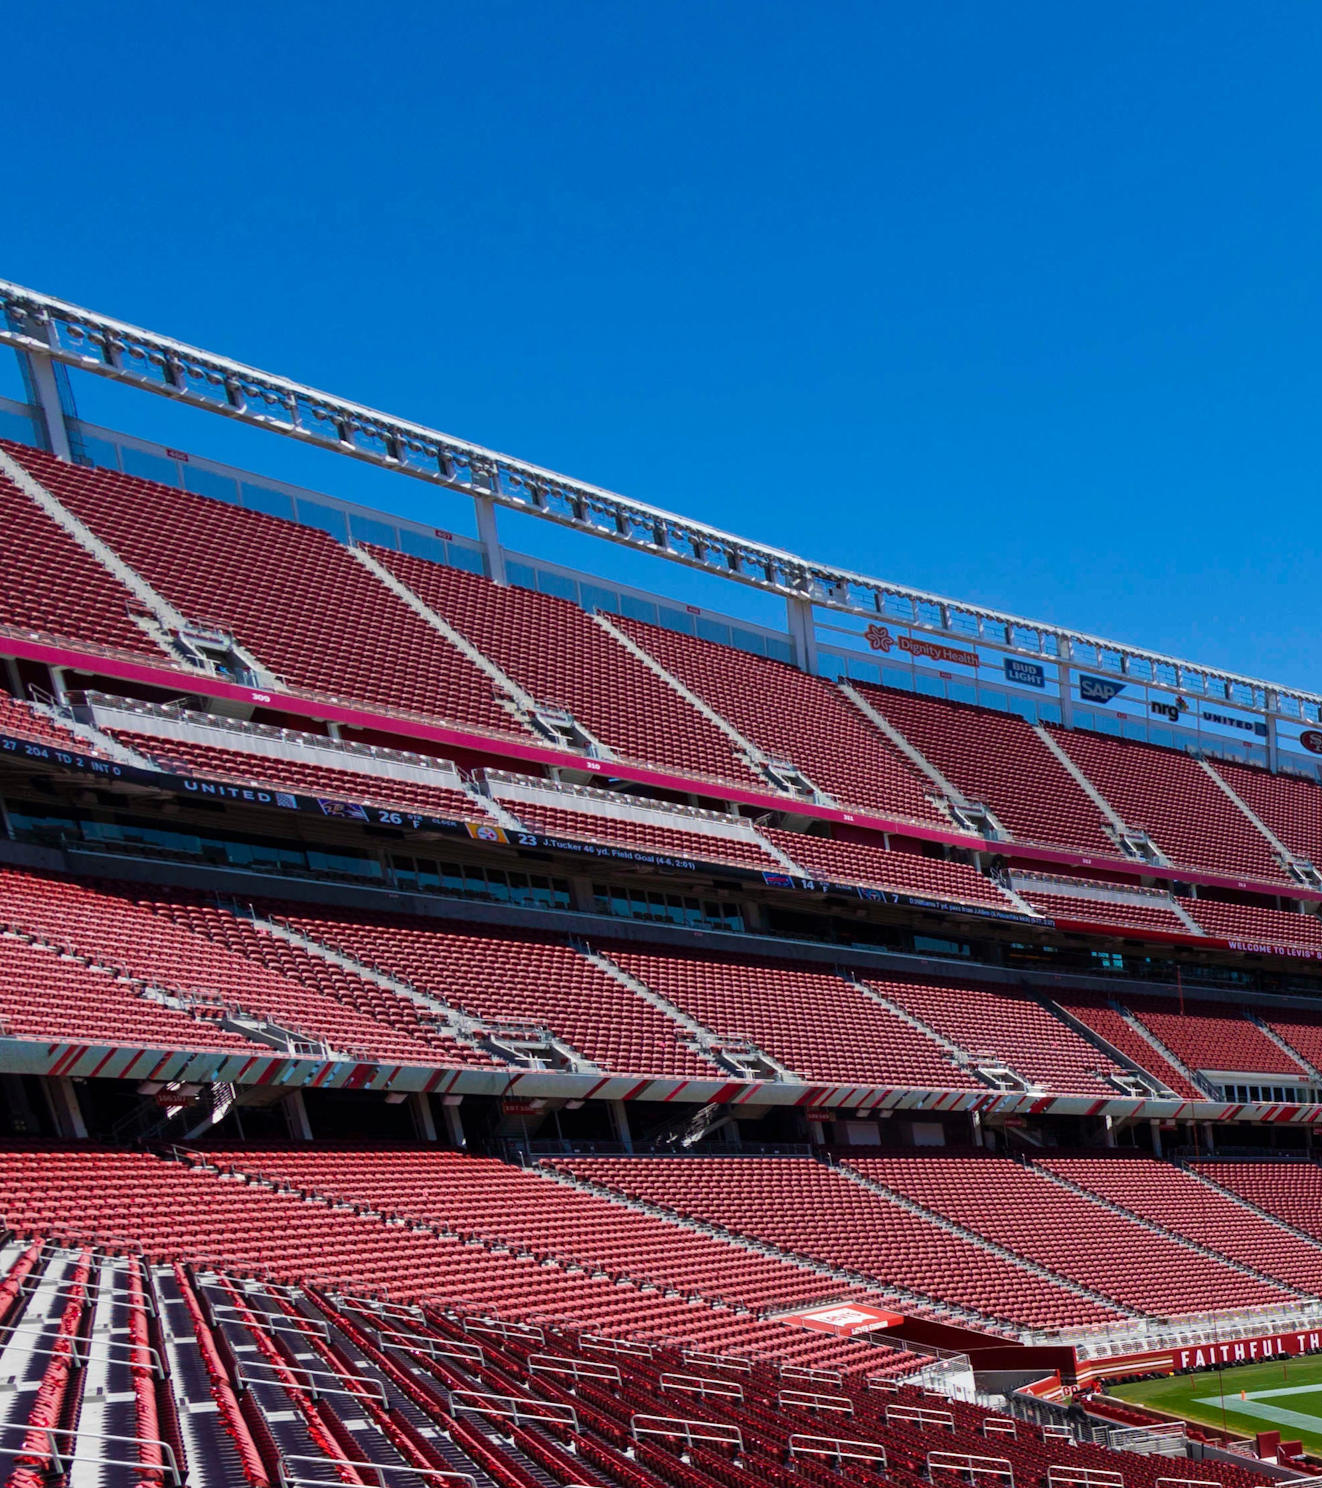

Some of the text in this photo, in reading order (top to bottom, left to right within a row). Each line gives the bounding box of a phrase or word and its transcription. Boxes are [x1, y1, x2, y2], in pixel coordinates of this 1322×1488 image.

[901, 638, 979, 667] Dignity Health
[1009, 669, 1042, 686] LIGHT
[1012, 662, 1037, 675] BUD
[251, 693, 271, 703] 309
[1082, 680, 1115, 699] SAP
[1151, 701, 1179, 722] nrg
[1204, 711, 1253, 731] UNITED
[2, 738, 17, 752] 27
[25, 744, 49, 759] 204
[55, 752, 73, 765] TD
[75, 757, 85, 769] 2
[91, 760, 111, 774] INT
[184, 780, 272, 803] UNITED
[378, 810, 402, 825] 26
[518, 833, 537, 847] 23
[542, 838, 583, 853] J.Tucker
[612, 849, 633, 861] Field
[634, 853, 655, 864] Goal
[801, 879, 815, 891] 14
[891, 894, 899, 904] 7
[1228, 940, 1272, 955] WELCOME
[1273, 946, 1285, 956] TO
[1181, 1338, 1287, 1369] FAITHFUL
